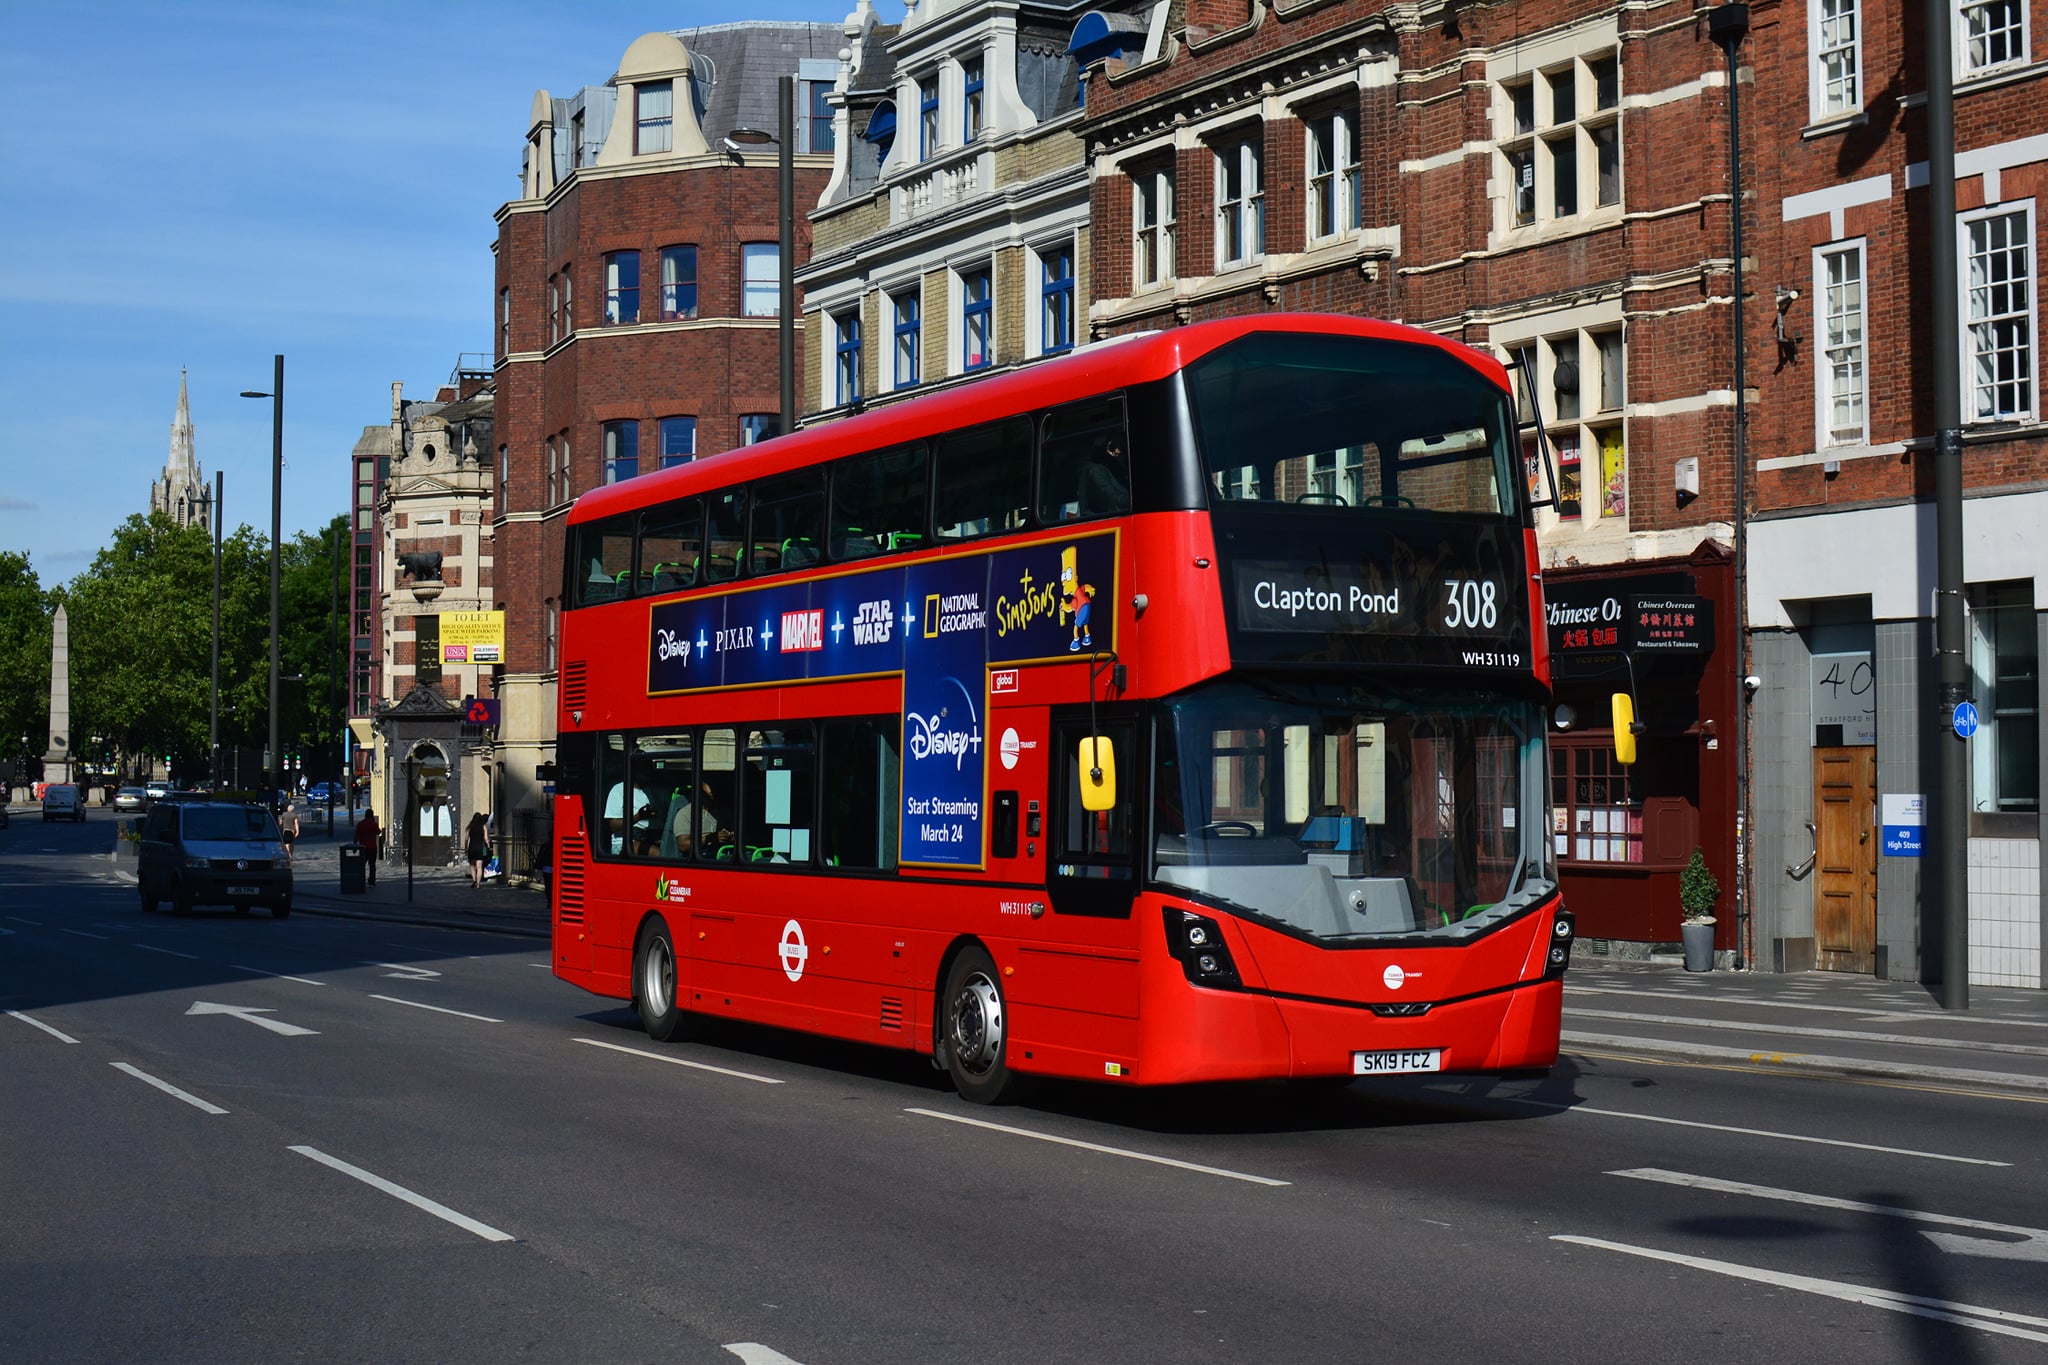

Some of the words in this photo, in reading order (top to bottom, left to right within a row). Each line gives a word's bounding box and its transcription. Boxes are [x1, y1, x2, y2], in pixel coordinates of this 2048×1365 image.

[941, 592, 980, 614] NATIONAL
[1254, 581, 1342, 617] Clapton
[1350, 585, 1399, 614] Pond
[1444, 579, 1497, 629] 308
[1637, 600, 1665, 609] Chinese
[1665, 600, 1695, 609] Overseas
[453, 613, 468, 622] TO
[470, 613, 490, 622] LET
[854, 599, 893, 624] STAR
[940, 610, 986, 633] GEOGRAPHIC
[715, 624, 754, 653] PIXAR
[780, 610, 824, 653] MARVEL
[852, 619, 892, 646] WARS
[1637, 640, 1667, 648] Restaurant
[1672, 640, 1699, 649] Takeaway
[1462, 651, 1520, 667] WH31119
[996, 673, 1013, 690] global
[1820, 660, 1875, 700] 40
[1820, 715, 1862, 723] STRATFORD
[908, 797, 930, 816] Start
[931, 797, 978, 821] Streaming
[921, 824, 949, 843] March
[951, 824, 963, 843] 24
[1898, 830, 1911, 839] 409
[1887, 840, 1902, 851] High
[1903, 840, 1922, 849] Street
[1363, 1053, 1398, 1071] SK19
[1401, 1052, 1431, 1069] FCZ
